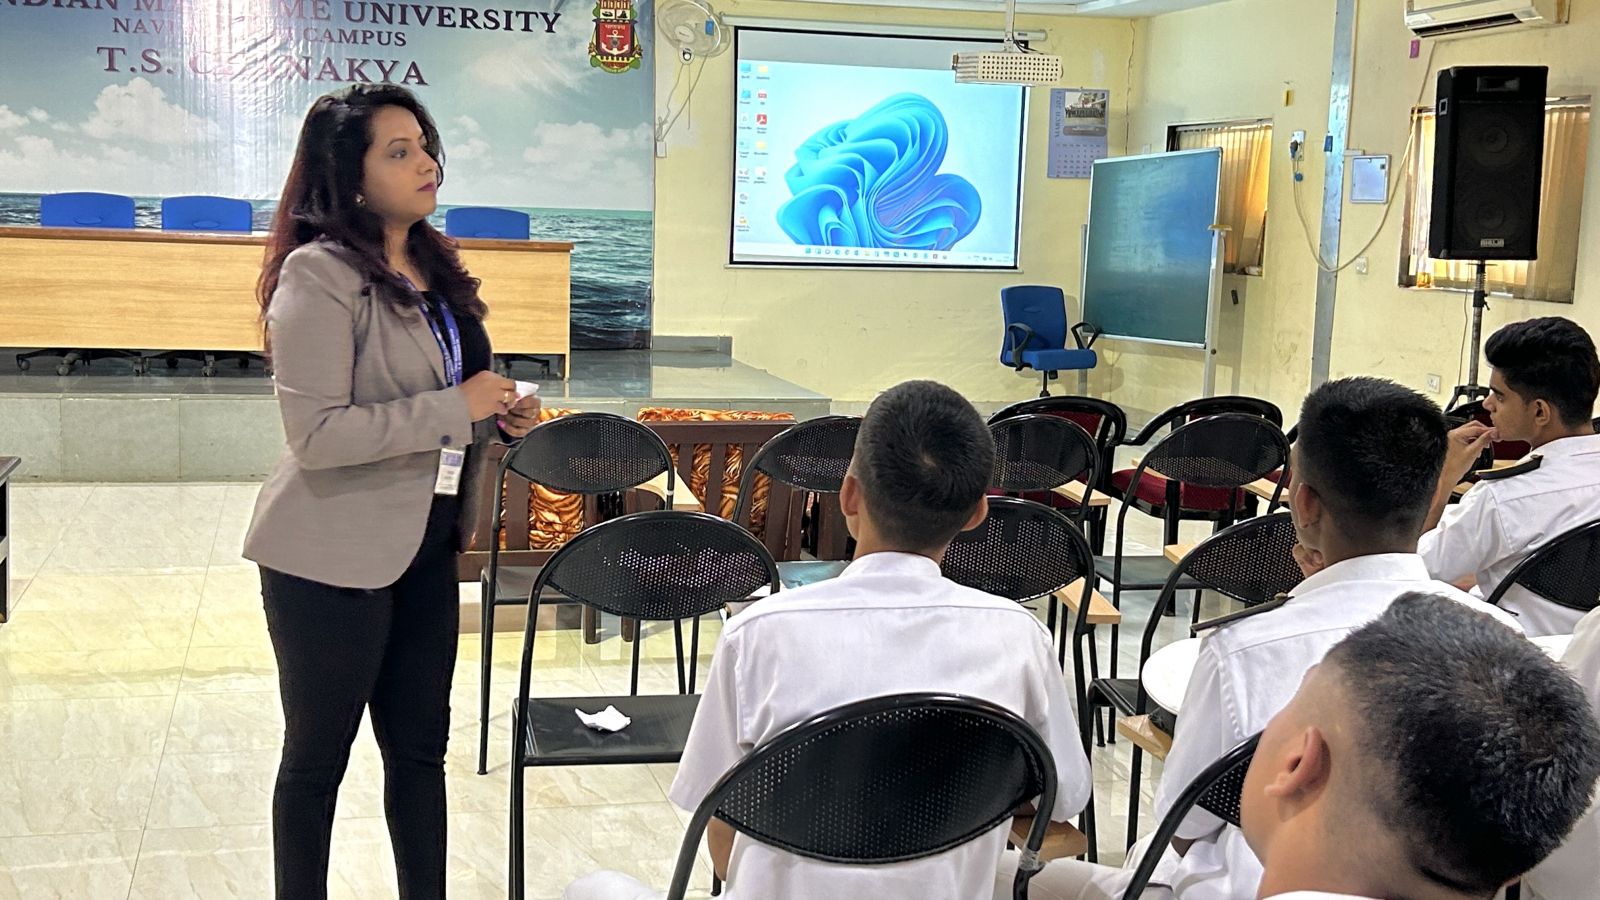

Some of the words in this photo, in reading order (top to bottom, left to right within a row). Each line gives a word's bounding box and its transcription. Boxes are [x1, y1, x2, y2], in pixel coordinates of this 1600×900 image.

[344, 0, 562, 33] UNIVERSITY
[303, 26, 407, 47] CAMPUS
[96, 46, 173, 74] T.S.
